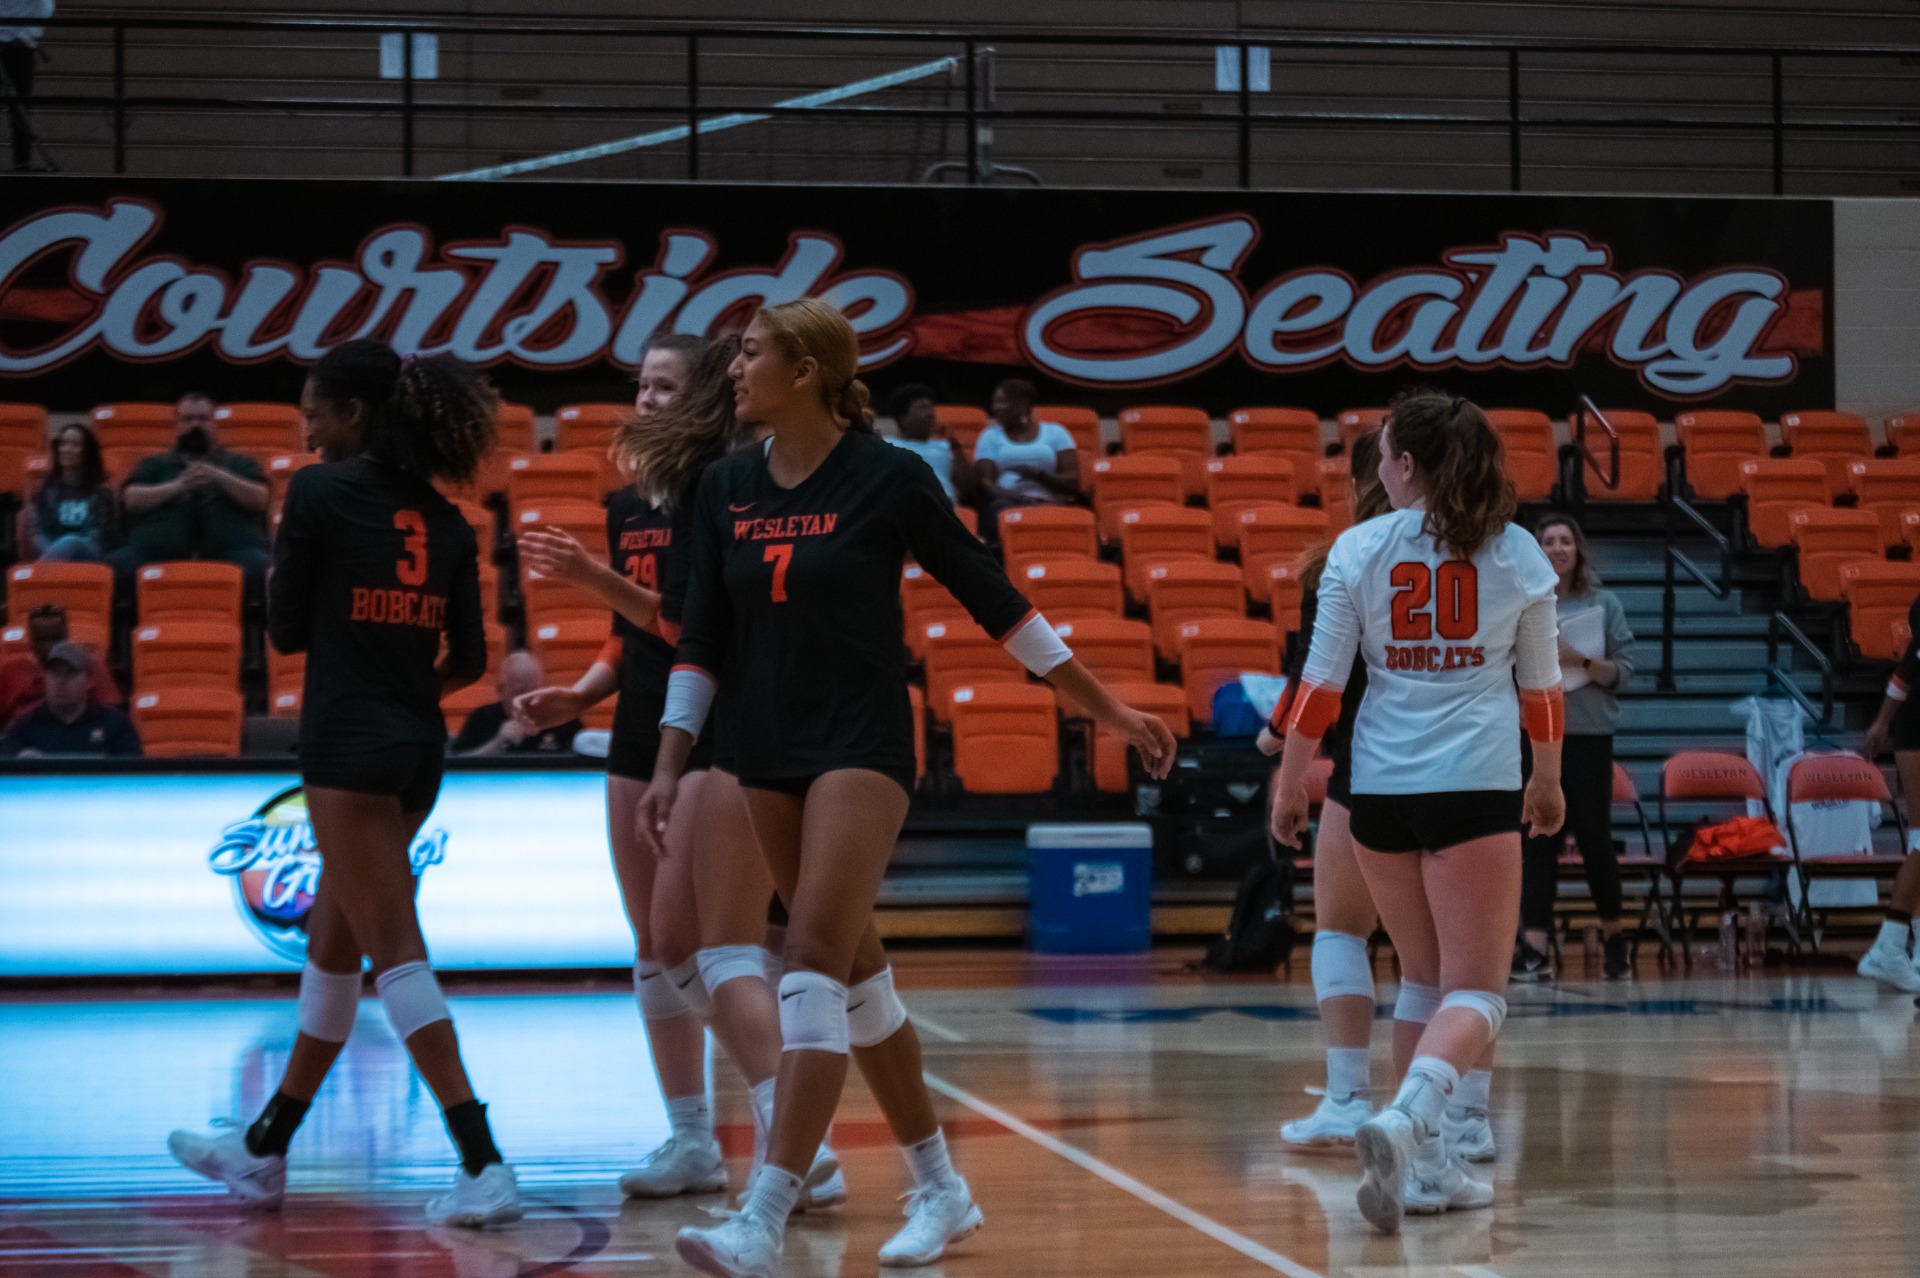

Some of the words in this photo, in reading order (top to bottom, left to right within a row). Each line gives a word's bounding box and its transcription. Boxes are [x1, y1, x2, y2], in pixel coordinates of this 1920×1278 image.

[0, 200, 912, 370] Courtside
[1021, 215, 1796, 395] Seating
[393, 508, 427, 587] 3
[733, 513, 839, 541] WESLEYAN
[763, 543, 794, 603] 7
[1390, 561, 1479, 641] 20
[1385, 645, 1486, 673] BOBCATS
[1678, 766, 1748, 780] WESLEYAN
[1804, 770, 1873, 784] WESLEYAN
